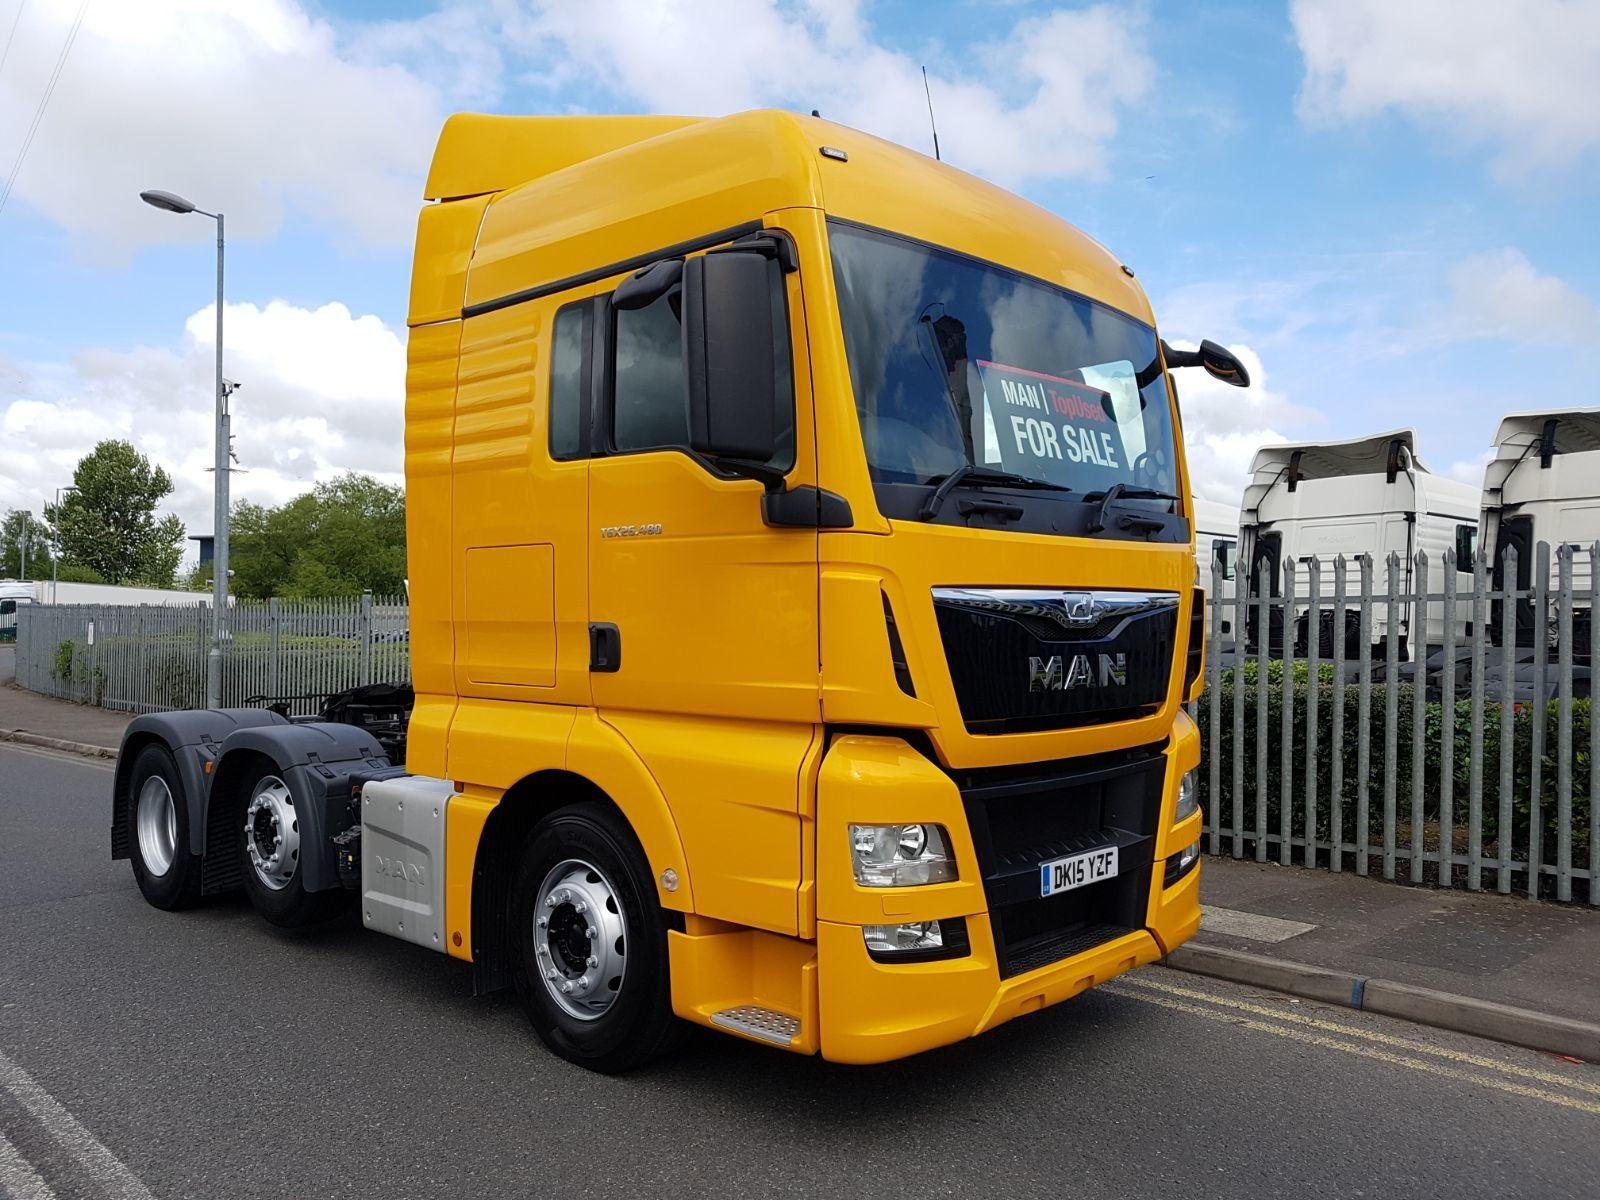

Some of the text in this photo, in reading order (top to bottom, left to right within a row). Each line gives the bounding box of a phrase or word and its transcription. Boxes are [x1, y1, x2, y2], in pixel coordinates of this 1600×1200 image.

[1001, 379, 1107, 424] MAN TopUsed
[1010, 415, 1119, 469] FOR SALE
[1028, 652, 1127, 693] MAN
[375, 855, 425, 887] MAN
[1054, 851, 1114, 890] DK15 YZF
